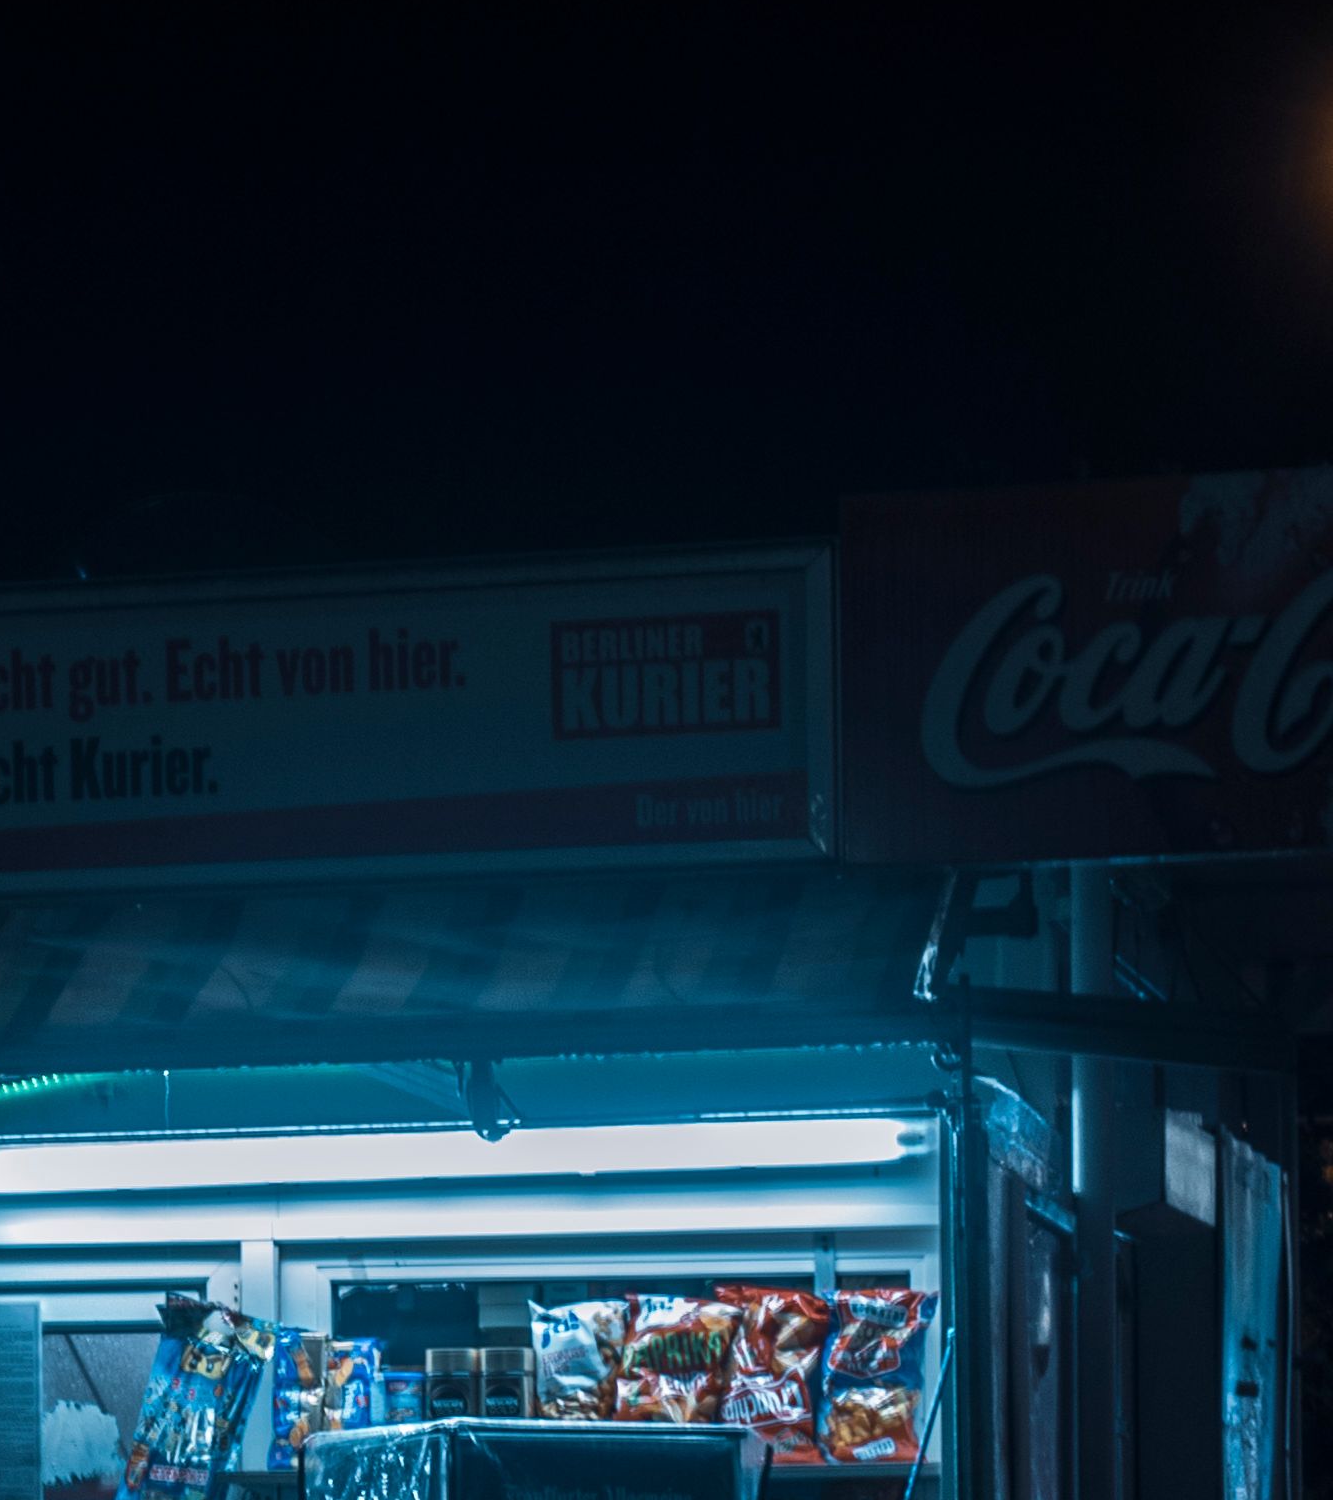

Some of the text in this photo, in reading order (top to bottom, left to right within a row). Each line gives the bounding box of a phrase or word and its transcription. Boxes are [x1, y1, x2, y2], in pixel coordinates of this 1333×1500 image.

[560, 619, 703, 663] BERLINER
[68, 645, 154, 720] gut.
[166, 635, 262, 700] Echt
[277, 646, 354, 694] von
[368, 627, 466, 691] hier.
[562, 658, 771, 730] KURIER
[70, 733, 218, 801] Kurier.
[686, 797, 729, 825] von
[733, 788, 785, 823] hier
[622, 1331, 723, 1376] PAPRIKA
